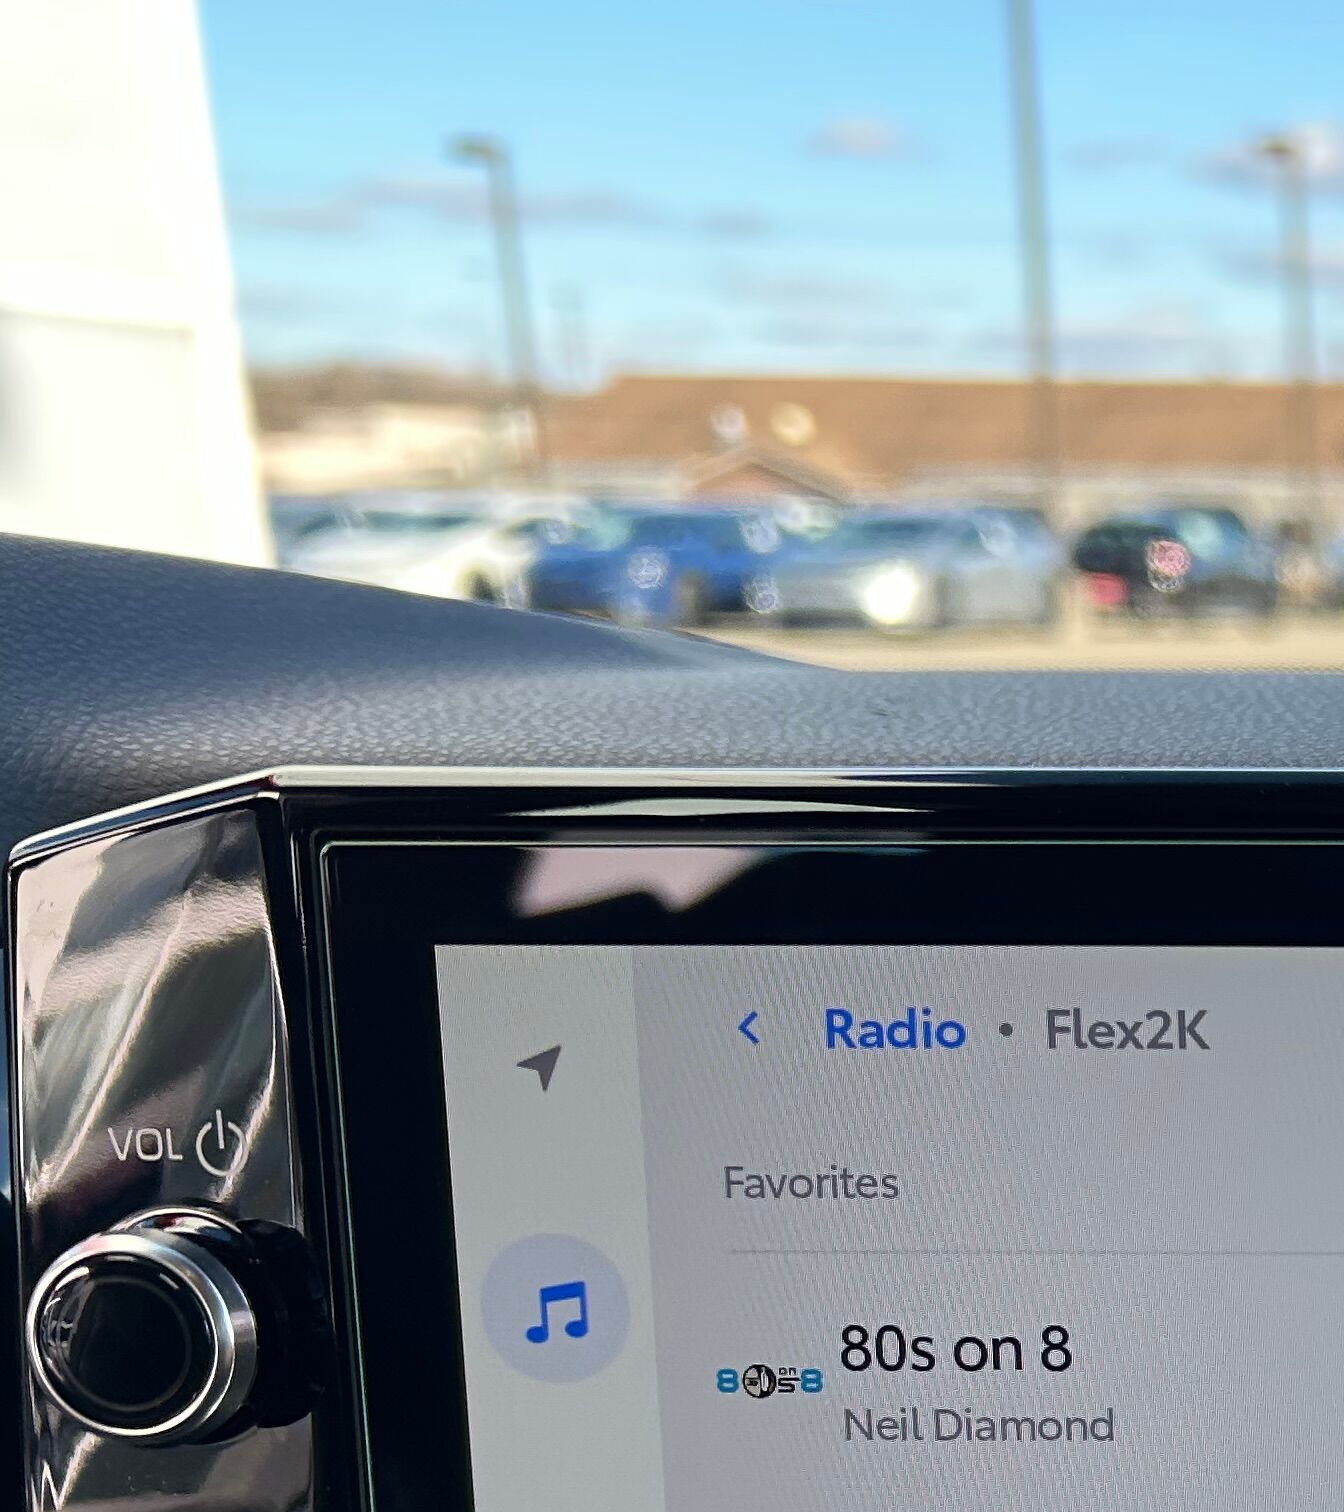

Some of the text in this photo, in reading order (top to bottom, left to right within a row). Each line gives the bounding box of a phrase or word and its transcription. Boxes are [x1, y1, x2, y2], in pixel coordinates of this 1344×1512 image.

[826, 1008, 1210, 1049] Radio Flex2K
[108, 1127, 183, 1161] VOL
[725, 1165, 898, 1199] Favorites
[841, 1325, 1071, 1371] 80s on 8
[845, 1407, 1113, 1441] Neil Diamond
